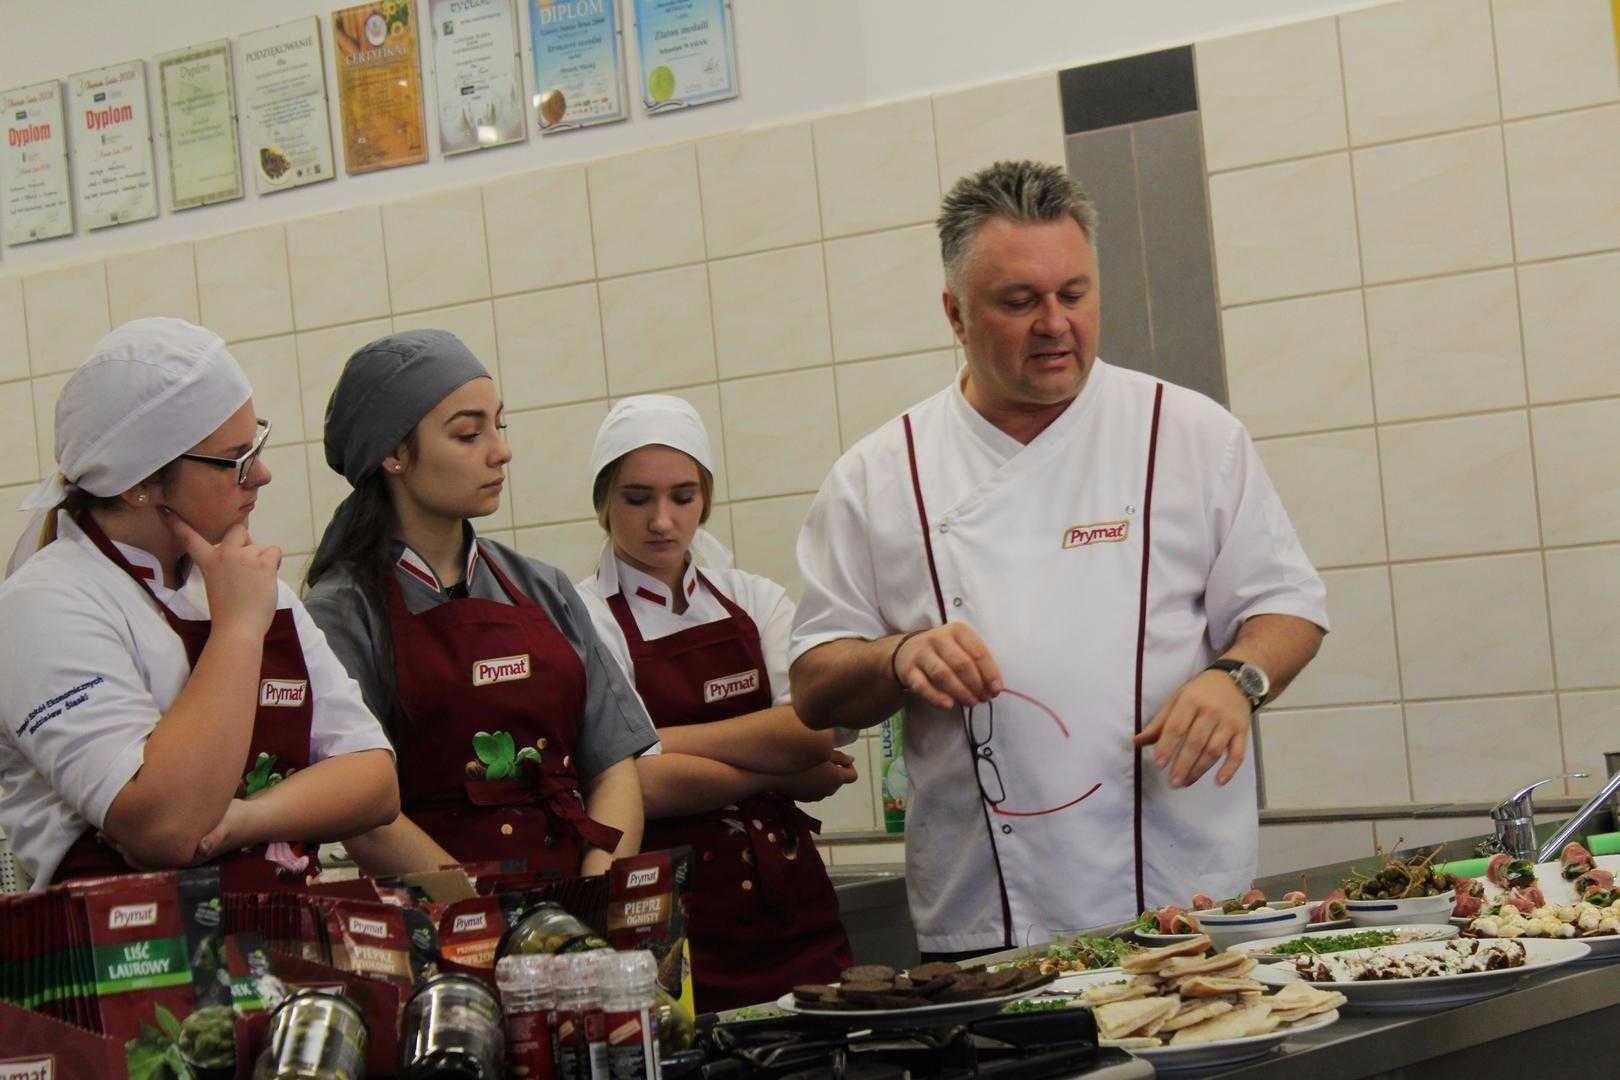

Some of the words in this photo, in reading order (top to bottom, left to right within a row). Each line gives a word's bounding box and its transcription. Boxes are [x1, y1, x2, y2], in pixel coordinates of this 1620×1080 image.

[541, 0, 604, 25] DIPLOM
[85, 104, 133, 130] Dyplom
[8, 122, 51, 148] Dyplom
[1069, 525, 1125, 545] Prymat
[479, 658, 527, 682] Prymat
[265, 683, 304, 705] Prymat
[709, 674, 755, 698] Prymat
[631, 871, 657, 887] Prymat
[624, 898, 662, 916] PIEPRZ
[113, 910, 153, 926] Prymat
[353, 920, 384, 937] Prymat
[455, 916, 484, 930] Prymat
[123, 941, 151, 962] LIŚĆ
[108, 957, 170, 980] LAUROWY
